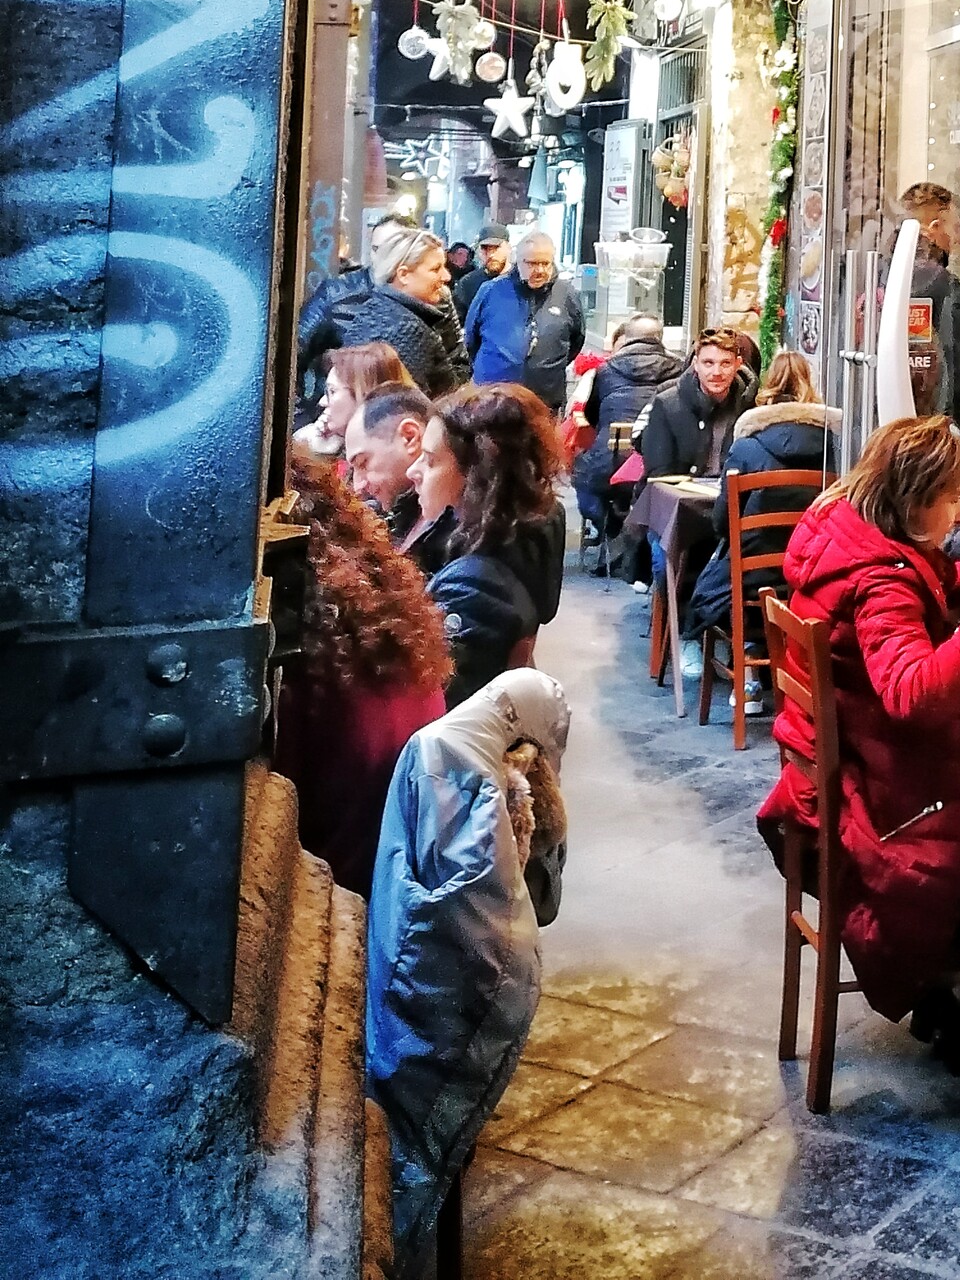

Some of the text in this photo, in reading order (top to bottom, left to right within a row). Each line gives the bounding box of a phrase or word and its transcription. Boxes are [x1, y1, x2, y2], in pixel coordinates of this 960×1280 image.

[909, 308, 927, 318] UST
[909, 317, 926, 327] EAT
[909, 356, 931, 368] ARE
